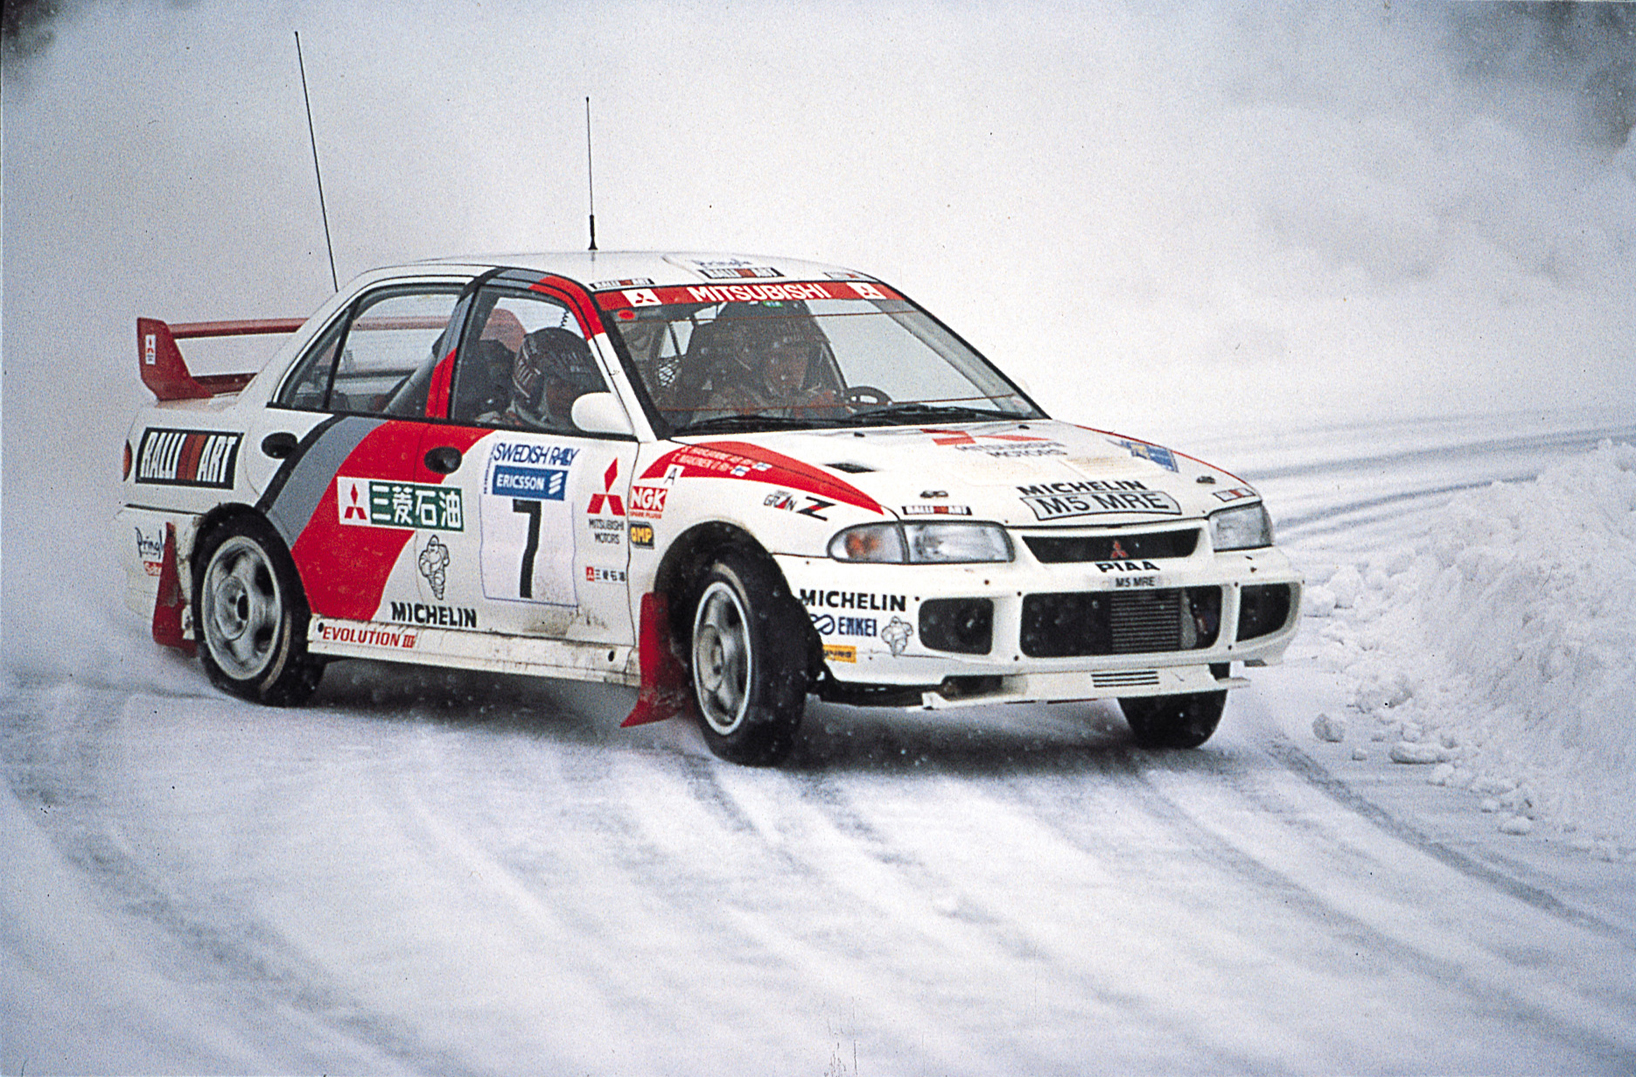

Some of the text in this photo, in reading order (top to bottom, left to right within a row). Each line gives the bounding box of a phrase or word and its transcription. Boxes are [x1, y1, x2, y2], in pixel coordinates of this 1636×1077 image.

[686, 283, 832, 302] MITSUBISHI
[196, 434, 239, 483] ART
[493, 442, 551, 465] SWEDISH
[496, 473, 546, 491] ERICSSON
[1016, 480, 1148, 496] MICHELIN
[371, 484, 462, 529] 三菱石油
[630, 487, 667, 510] NGK
[1035, 493, 1170, 515] M5 MRE
[594, 532, 620, 545] MOTORS
[630, 526, 653, 544] OMP
[512, 498, 542, 599] 7
[1095, 560, 1161, 573] PIAA
[1115, 575, 1156, 588] M5 MRE
[799, 588, 907, 613] MICHELIN
[390, 601, 478, 628] MICHELIN
[322, 625, 400, 648] EVOLUTION
[837, 615, 878, 638] ENKEI
